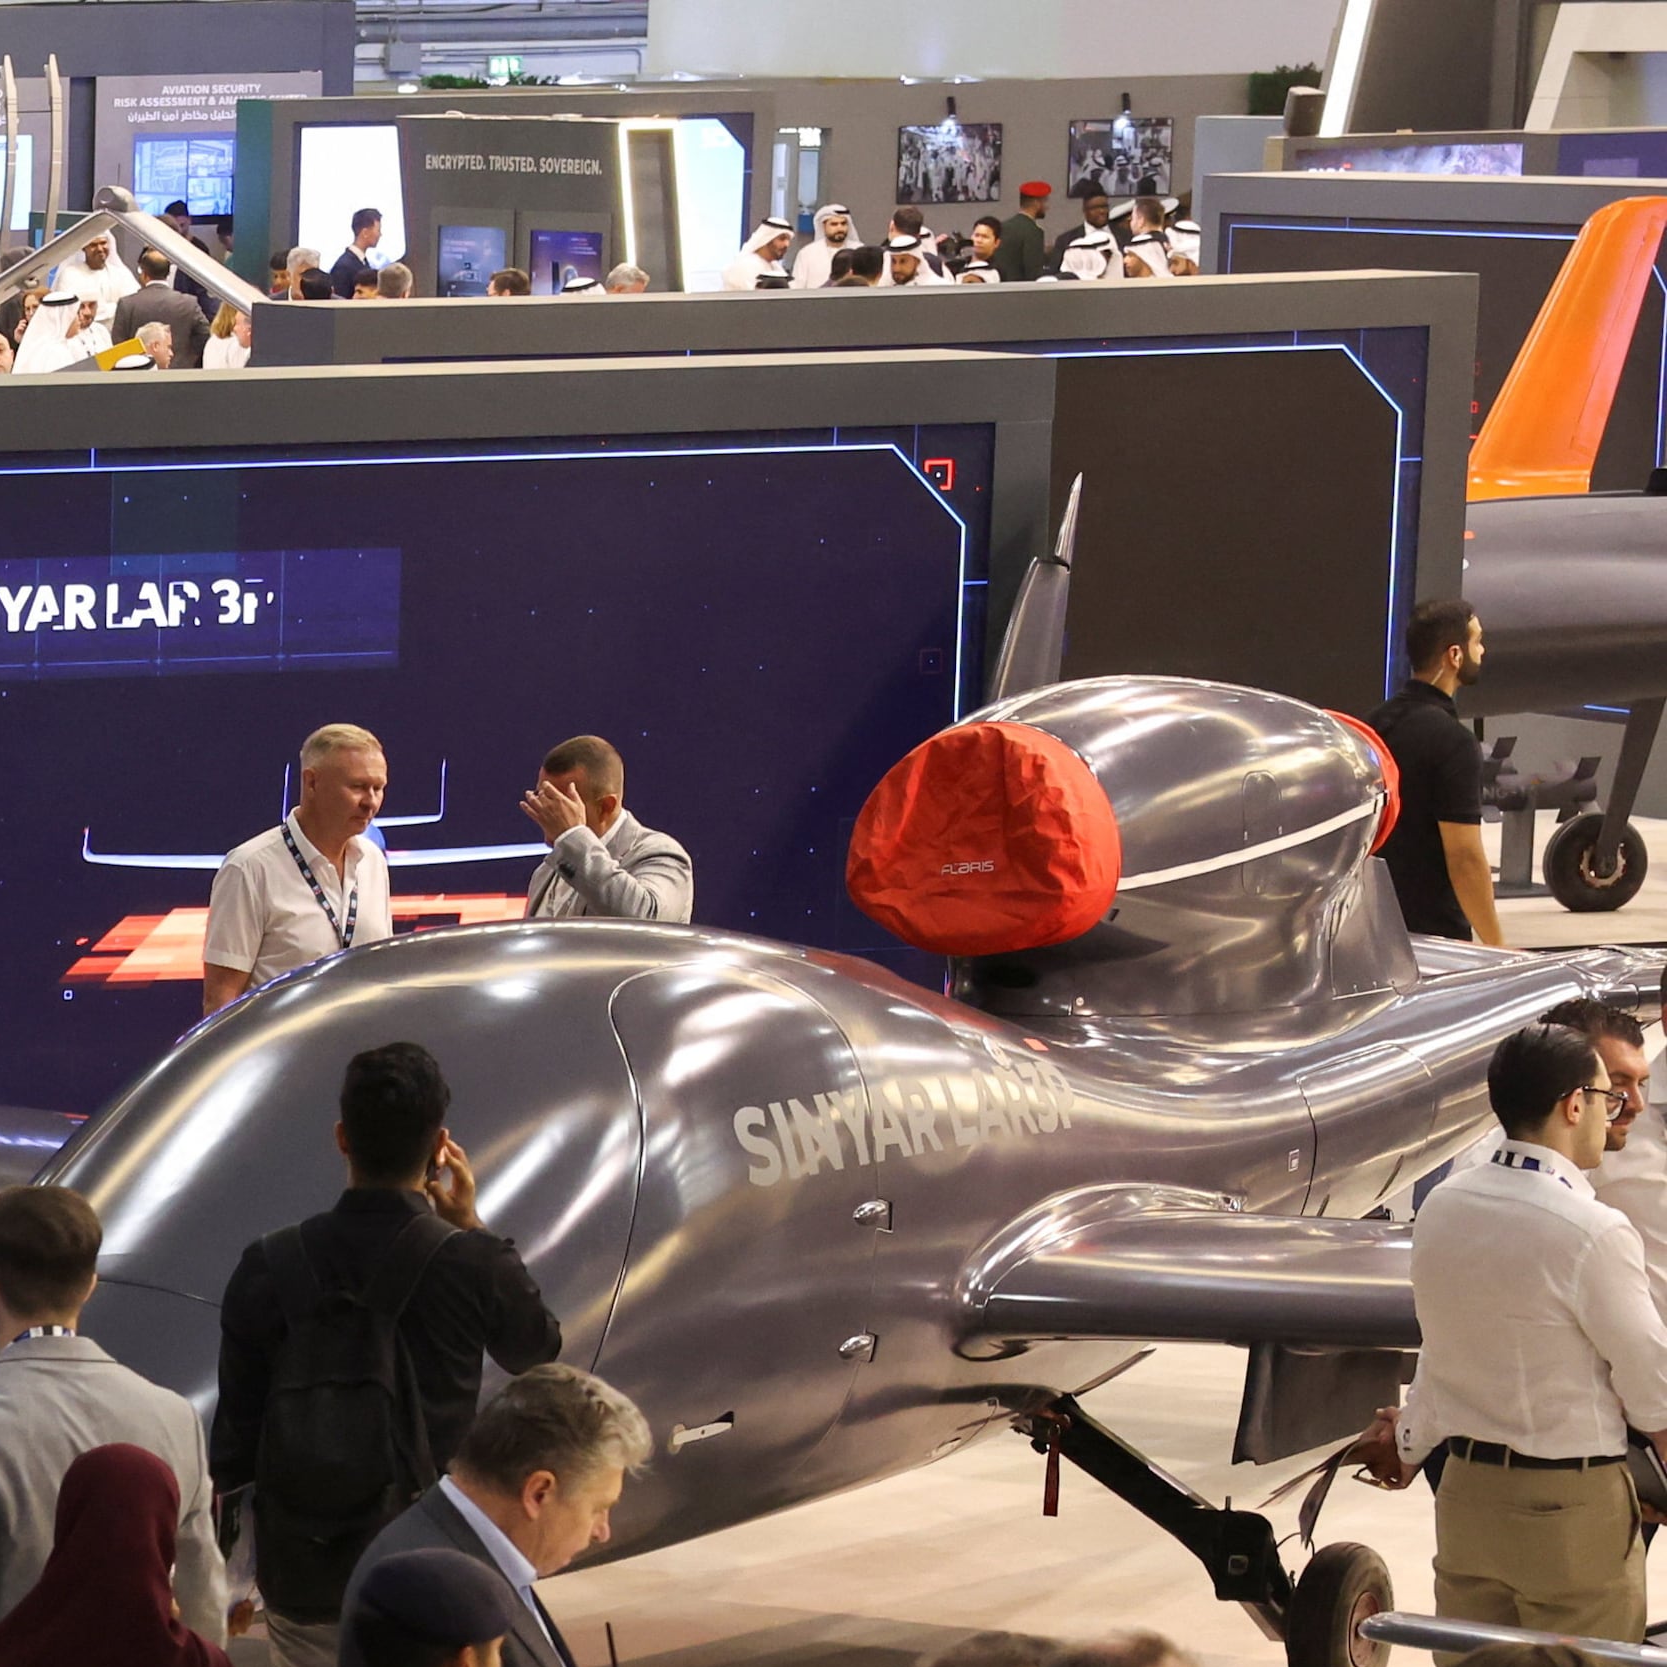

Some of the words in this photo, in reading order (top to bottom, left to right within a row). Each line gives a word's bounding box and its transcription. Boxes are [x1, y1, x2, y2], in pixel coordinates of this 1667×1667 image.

[162, 84, 209, 95] AVIATION
[211, 83, 261, 94] SECURITY
[114, 98, 137, 108] RISK
[139, 97, 207, 108] ASSESSMENT
[425, 154, 486, 170] ENCRYPTED.
[489, 155, 537, 173] TRUSTED.
[539, 157, 602, 175] SOVEREIGN.
[733, 1077, 943, 1187] SINYAR
